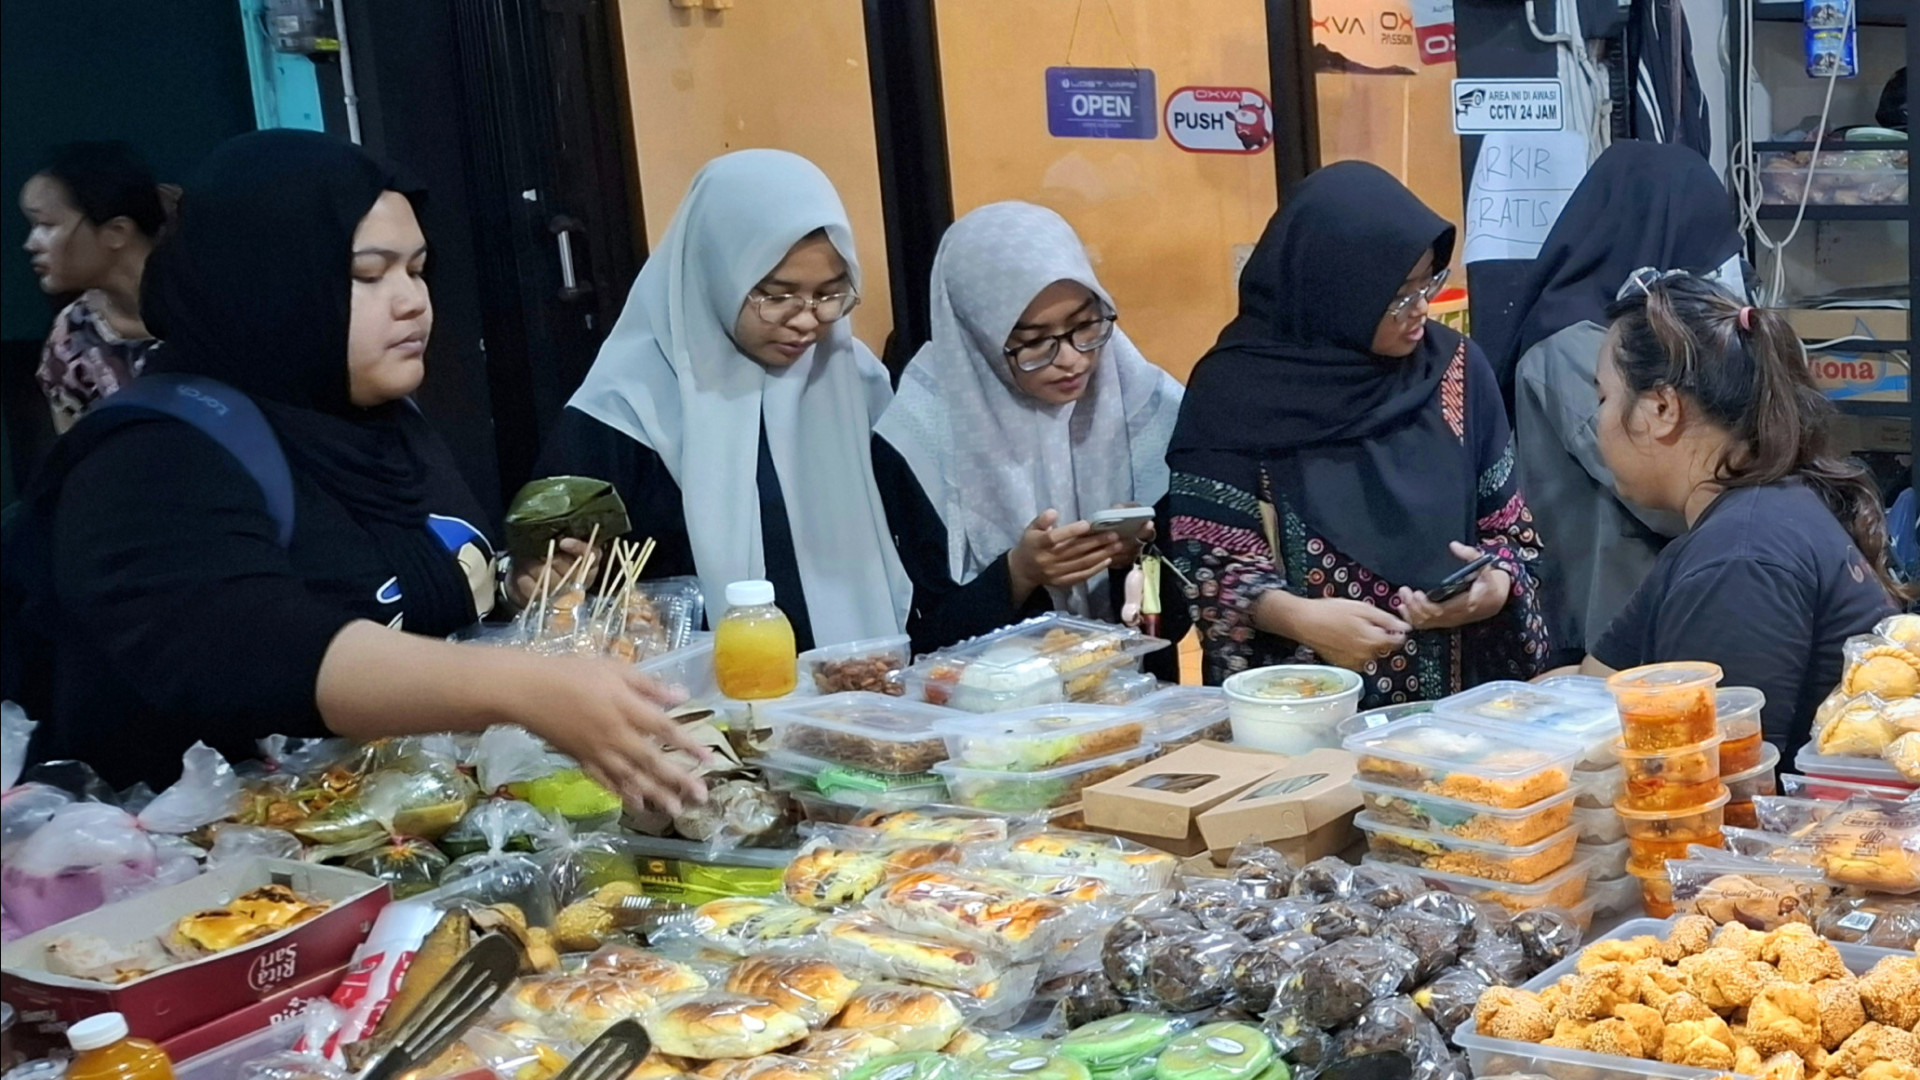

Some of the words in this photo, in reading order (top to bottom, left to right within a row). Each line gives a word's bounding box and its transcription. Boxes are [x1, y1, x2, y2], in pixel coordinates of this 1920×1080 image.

[1195, 90, 1242, 100] OXVA
[1488, 91, 1510, 101] AREA
[1511, 91, 1521, 101] INI
[1523, 91, 1530, 101] DI
[1532, 91, 1557, 101] AWASI
[1071, 94, 1131, 117] OPEN
[1489, 105, 1517, 120] CCTV
[1520, 105, 1533, 120] 24
[1535, 105, 1557, 120] JAM
[1174, 112, 1224, 130] PUSH
